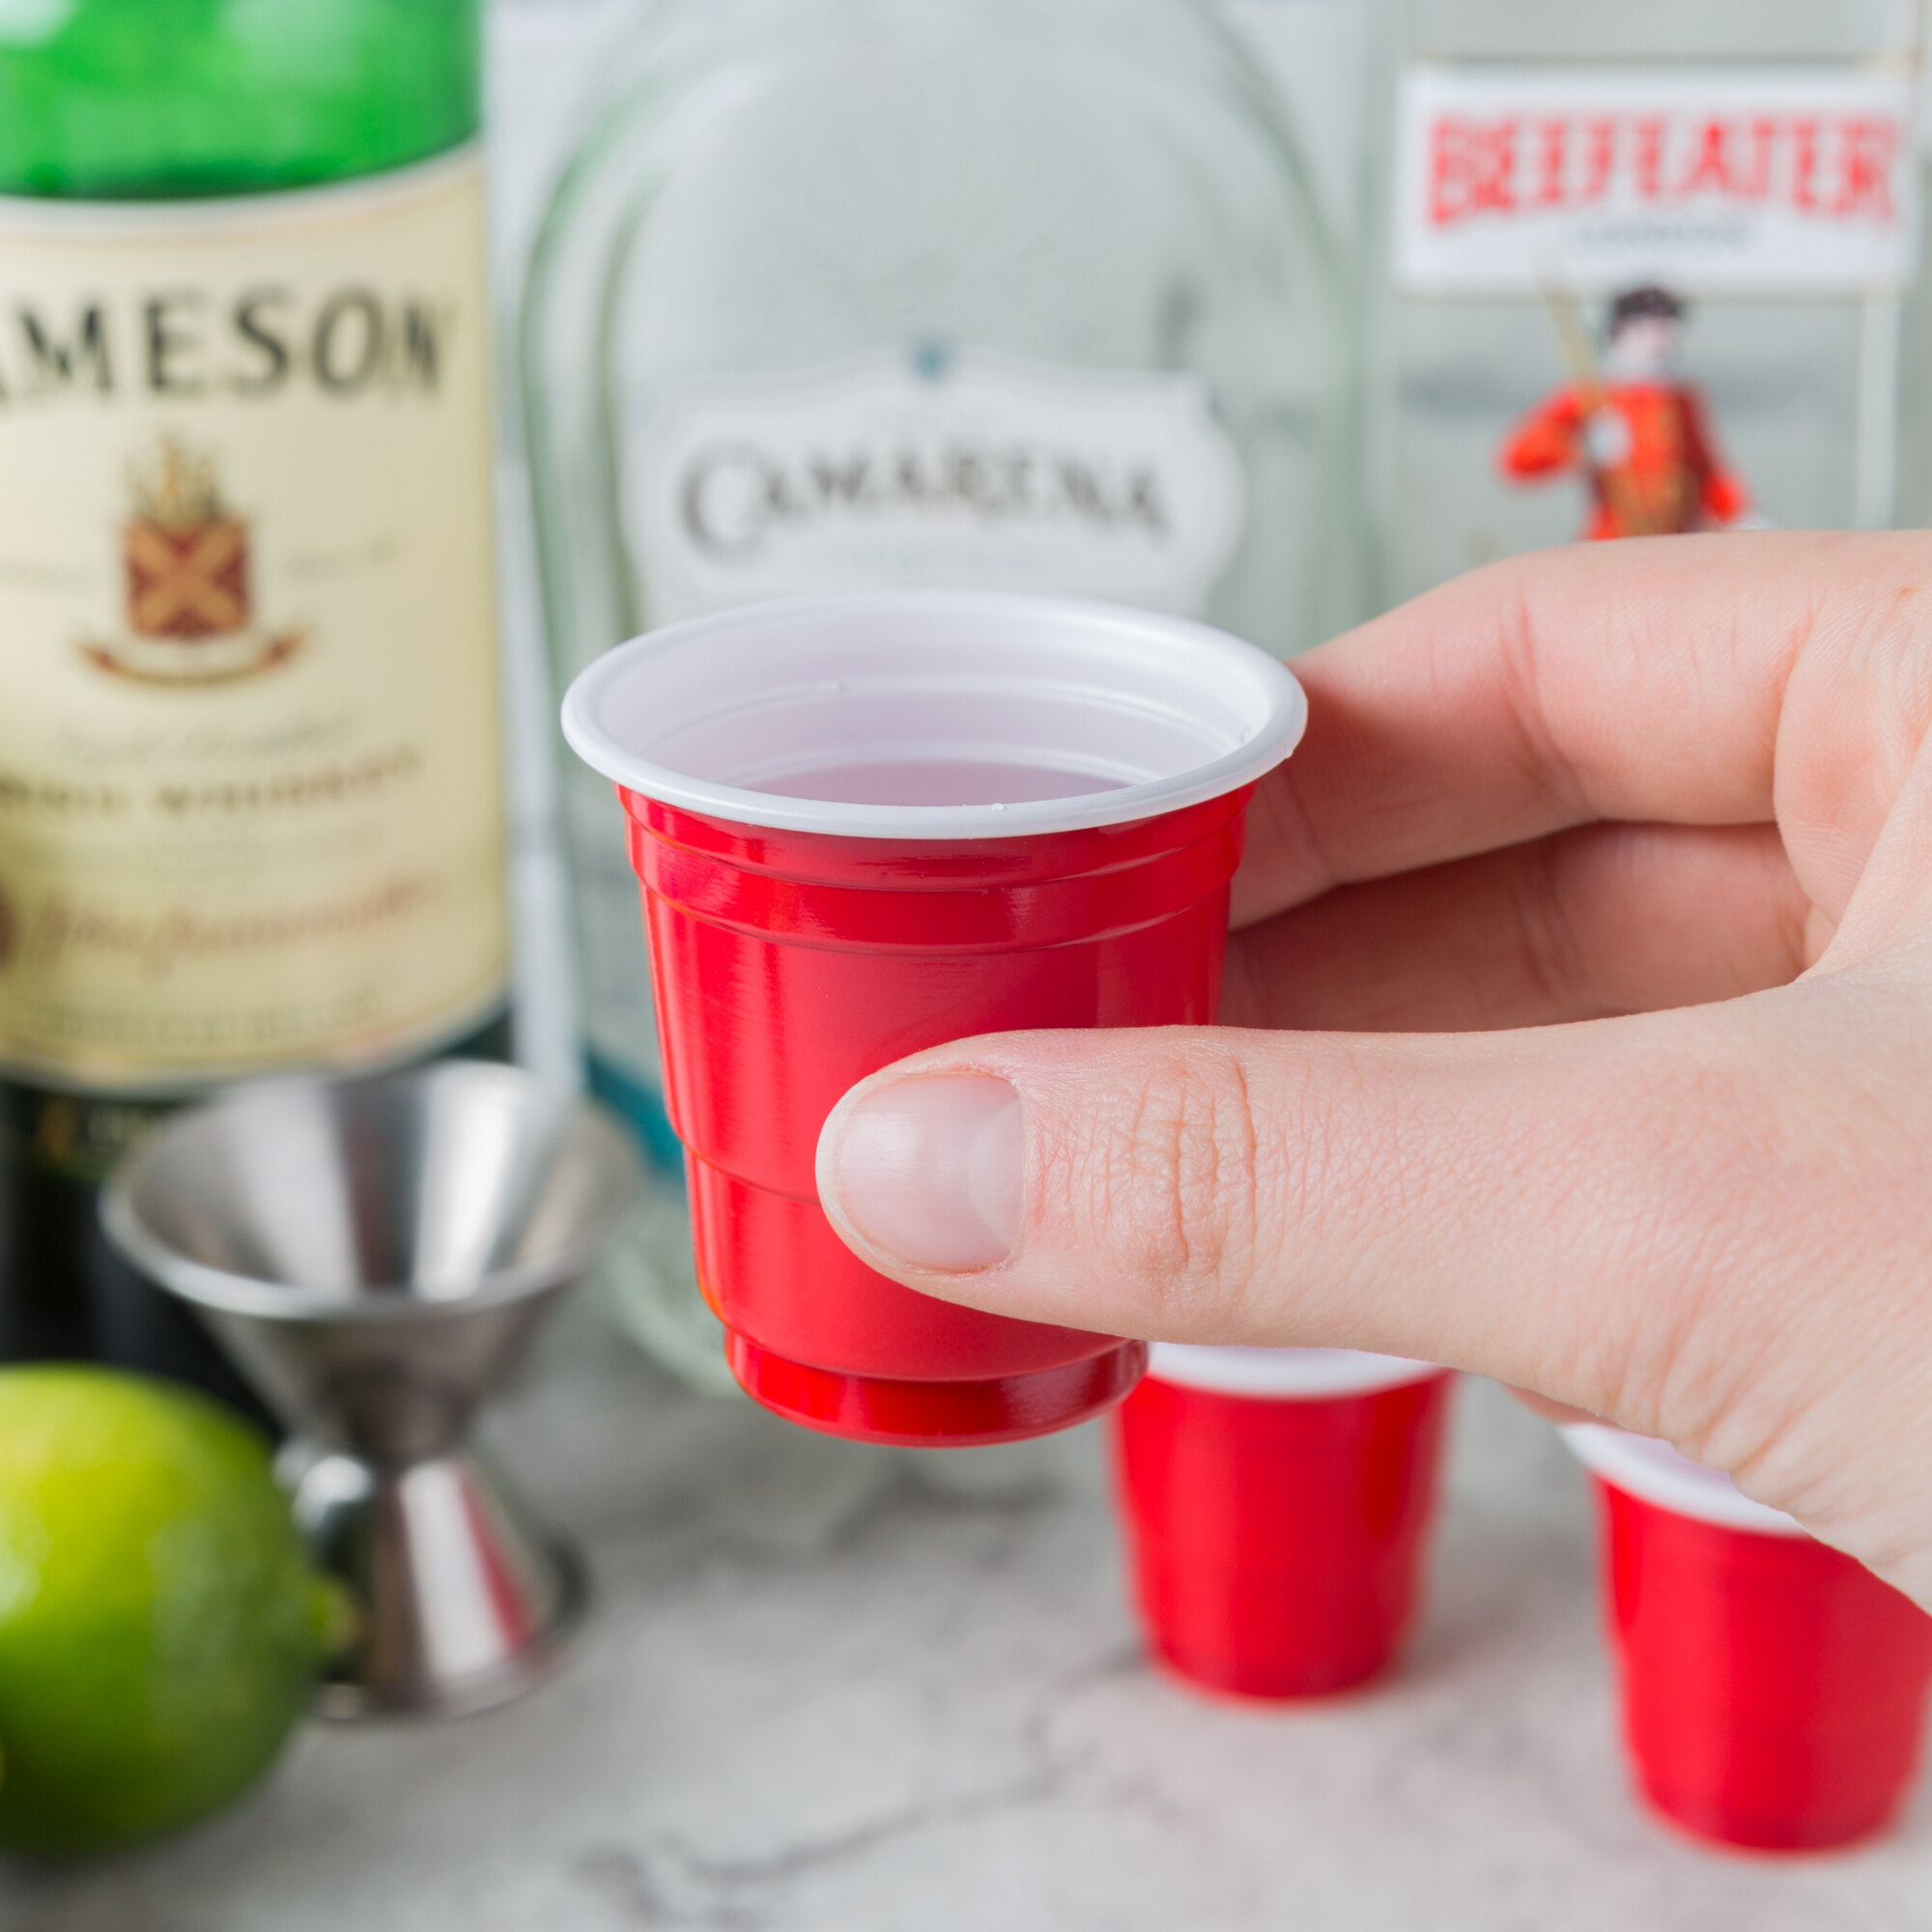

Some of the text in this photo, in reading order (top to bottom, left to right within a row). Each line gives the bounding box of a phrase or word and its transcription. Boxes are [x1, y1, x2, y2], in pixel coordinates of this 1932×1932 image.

[1427, 112, 1899, 230] BEEFEATER
[0, 283, 454, 415] MESON
[679, 437, 1176, 562] CAMARENA
